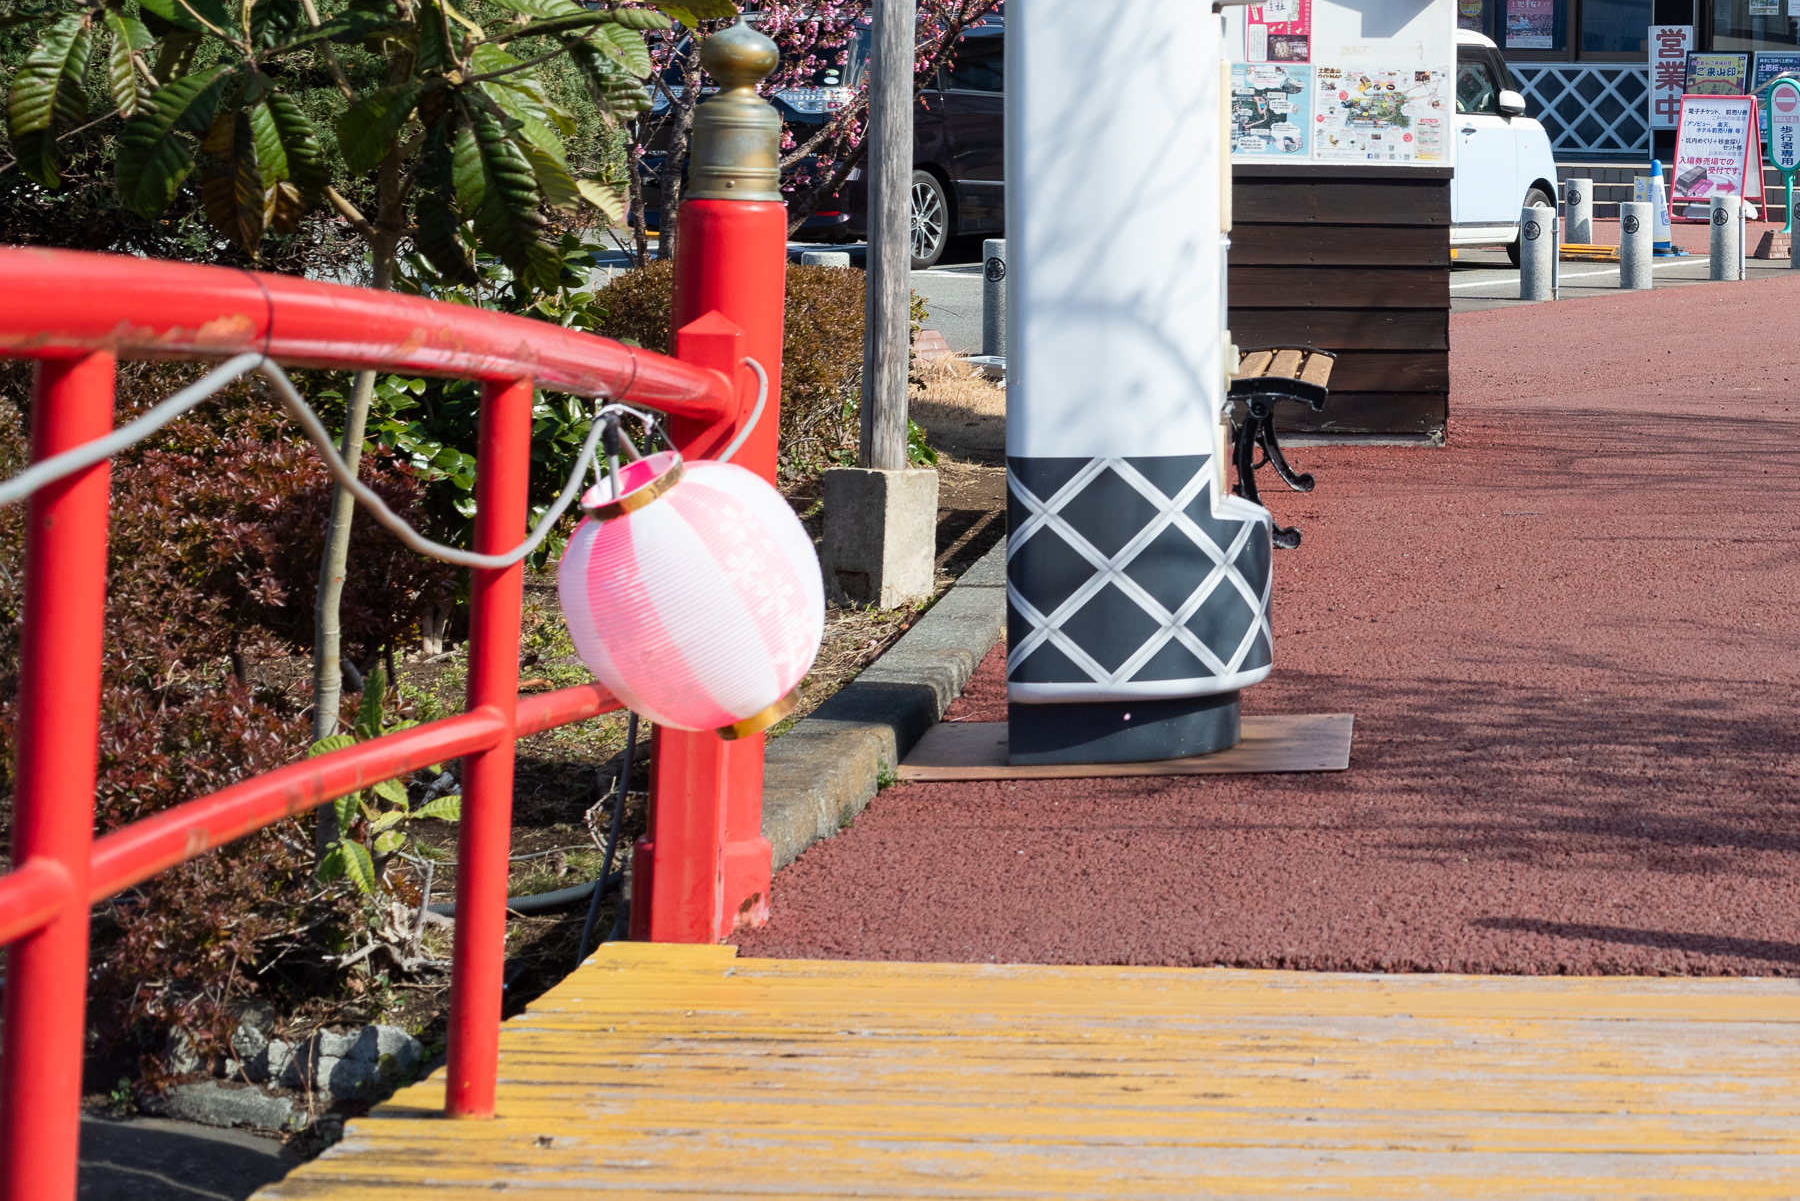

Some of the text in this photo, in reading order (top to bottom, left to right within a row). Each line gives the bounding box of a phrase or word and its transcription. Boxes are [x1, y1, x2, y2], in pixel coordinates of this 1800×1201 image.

[1655, 28, 1687, 124] 営業中
[1780, 126, 1794, 166] 歩行者専用
[1678, 156, 1734, 166] 入場券売場での
[1708, 166, 1742, 176] 受付です。
